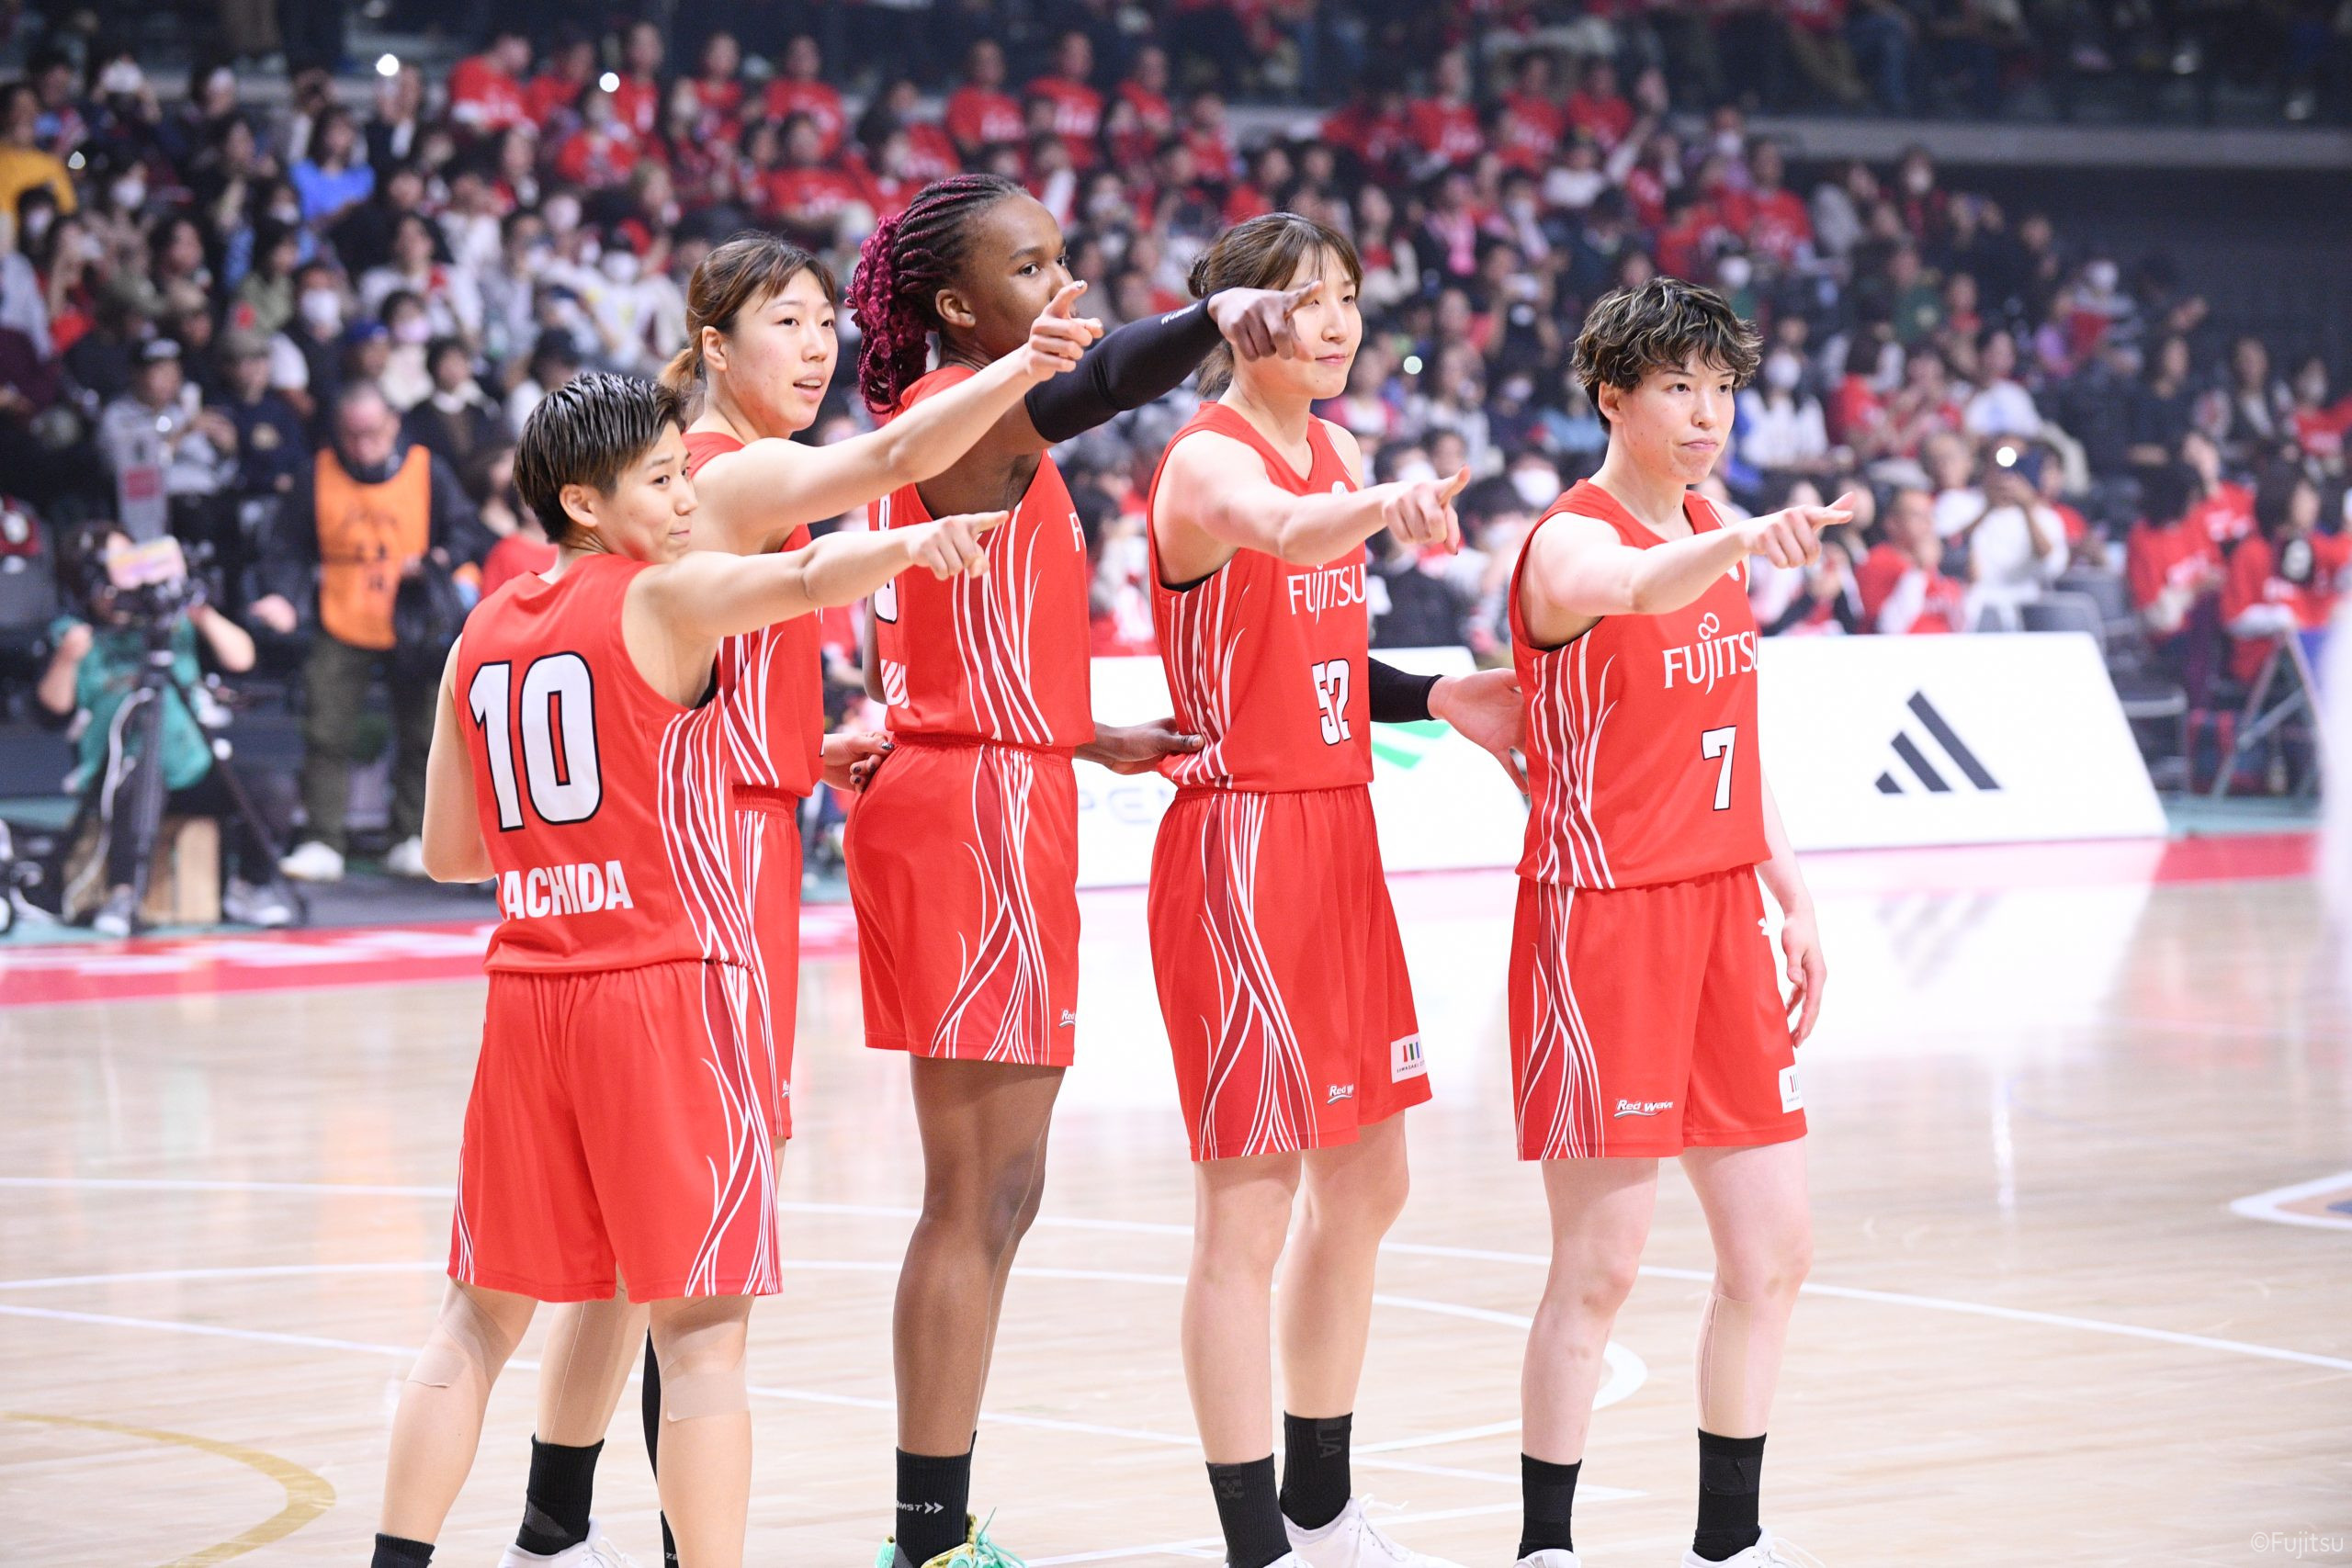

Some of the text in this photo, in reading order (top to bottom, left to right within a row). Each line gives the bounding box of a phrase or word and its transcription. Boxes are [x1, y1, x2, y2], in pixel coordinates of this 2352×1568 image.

[1287, 562, 1367, 626] FUJITSU
[1311, 658, 1351, 746] 52
[468, 650, 604, 833] 10
[1701, 725, 1737, 812] 7
[496, 860, 635, 921] ACHIDA
[1617, 1100, 1642, 1111] Red
